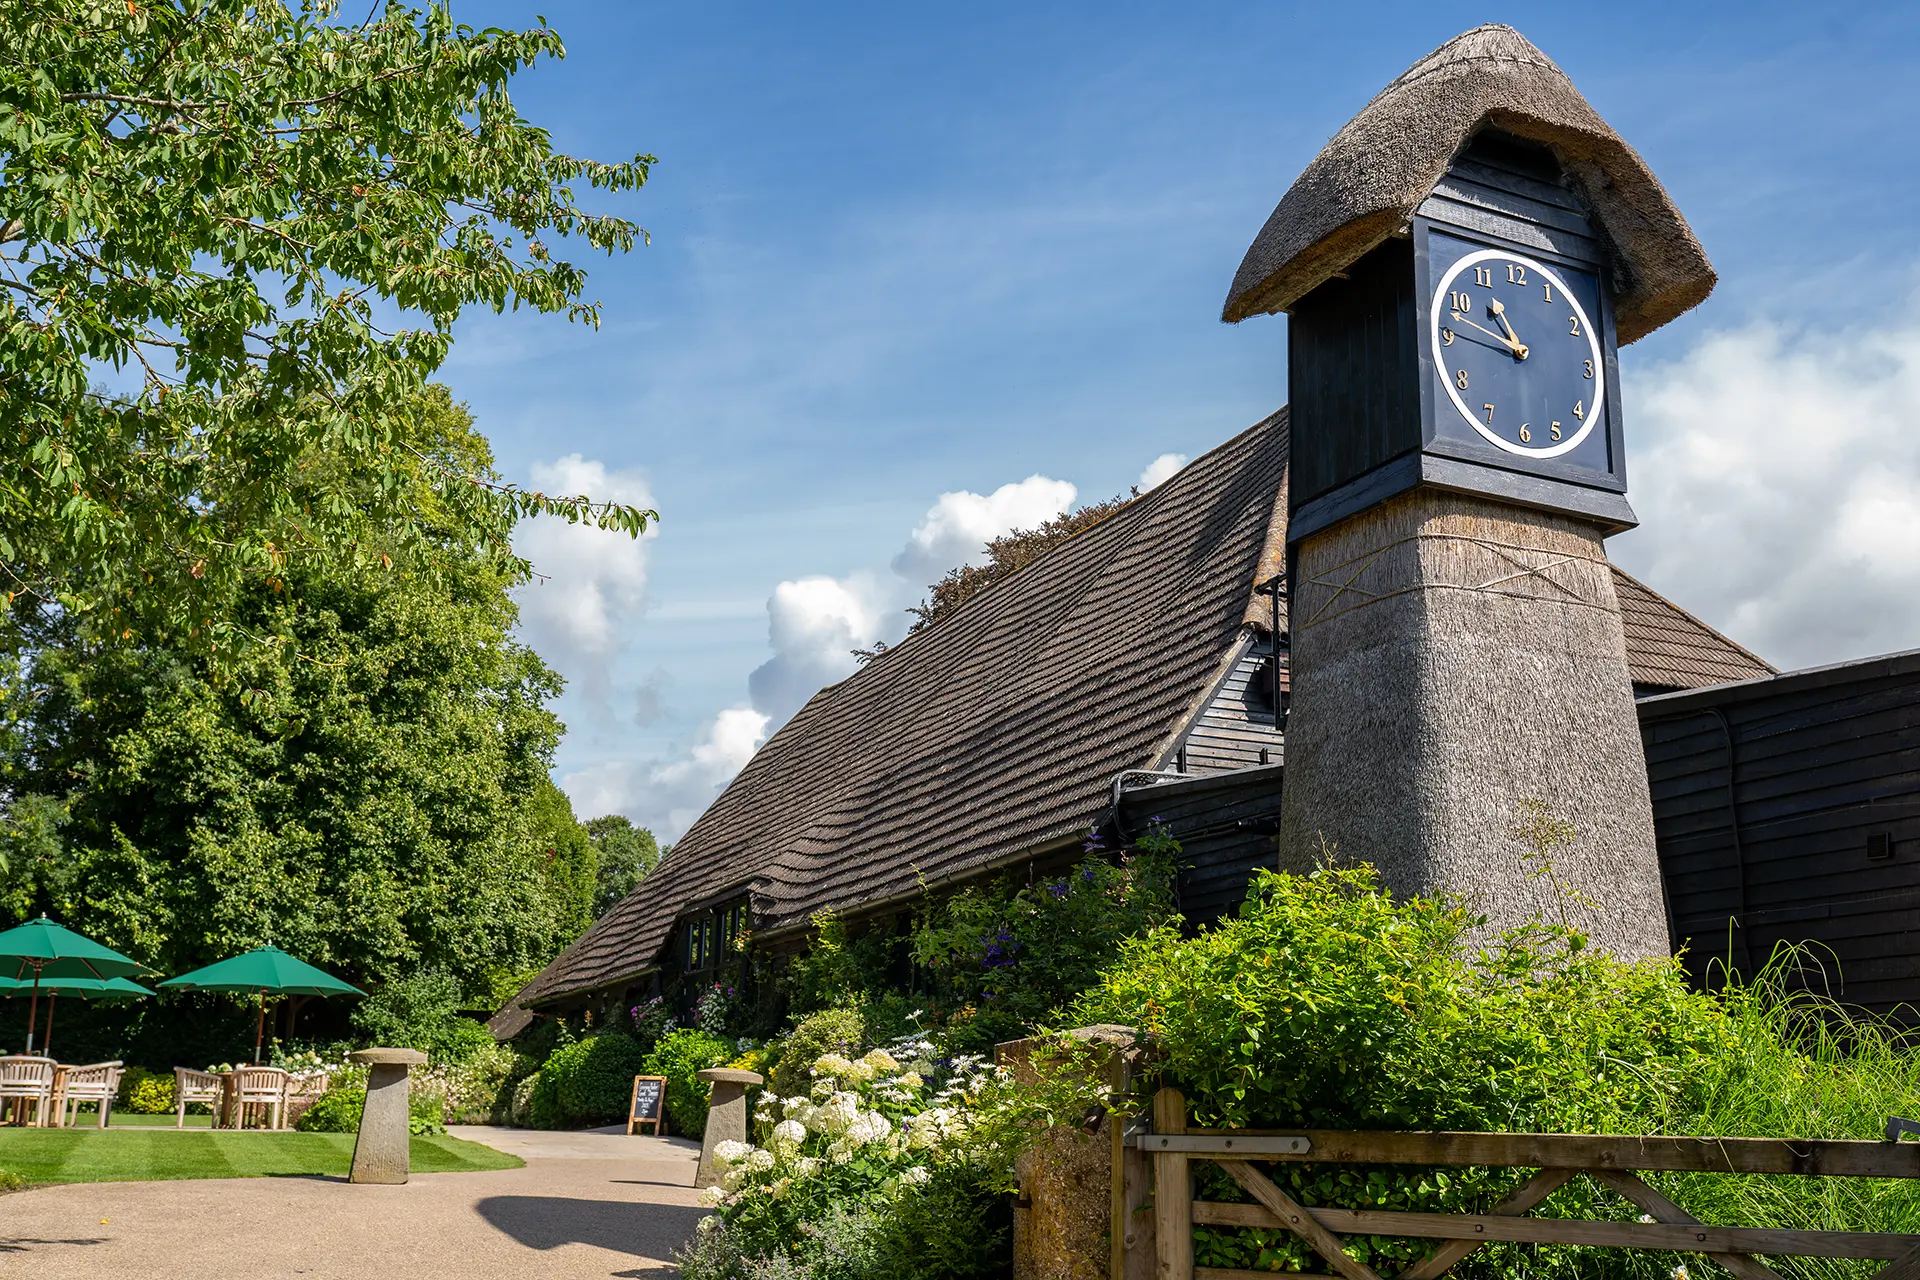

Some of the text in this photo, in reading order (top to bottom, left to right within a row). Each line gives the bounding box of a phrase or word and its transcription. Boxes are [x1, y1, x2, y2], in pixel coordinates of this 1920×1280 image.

[1474, 266, 1492, 288] 11
[1506, 264, 1527, 286] 12
[1450, 290, 1471, 313] 10
[1543, 284, 1552, 303] 1
[1568, 316, 1580, 337] 2
[1442, 328, 1455, 347] 9
[1456, 369, 1468, 390] 8
[1583, 359, 1593, 379] 3
[1483, 403, 1494, 424] 7
[1572, 400, 1584, 420] 4
[1519, 422, 1531, 443] 6
[1551, 421, 1562, 441] 5
